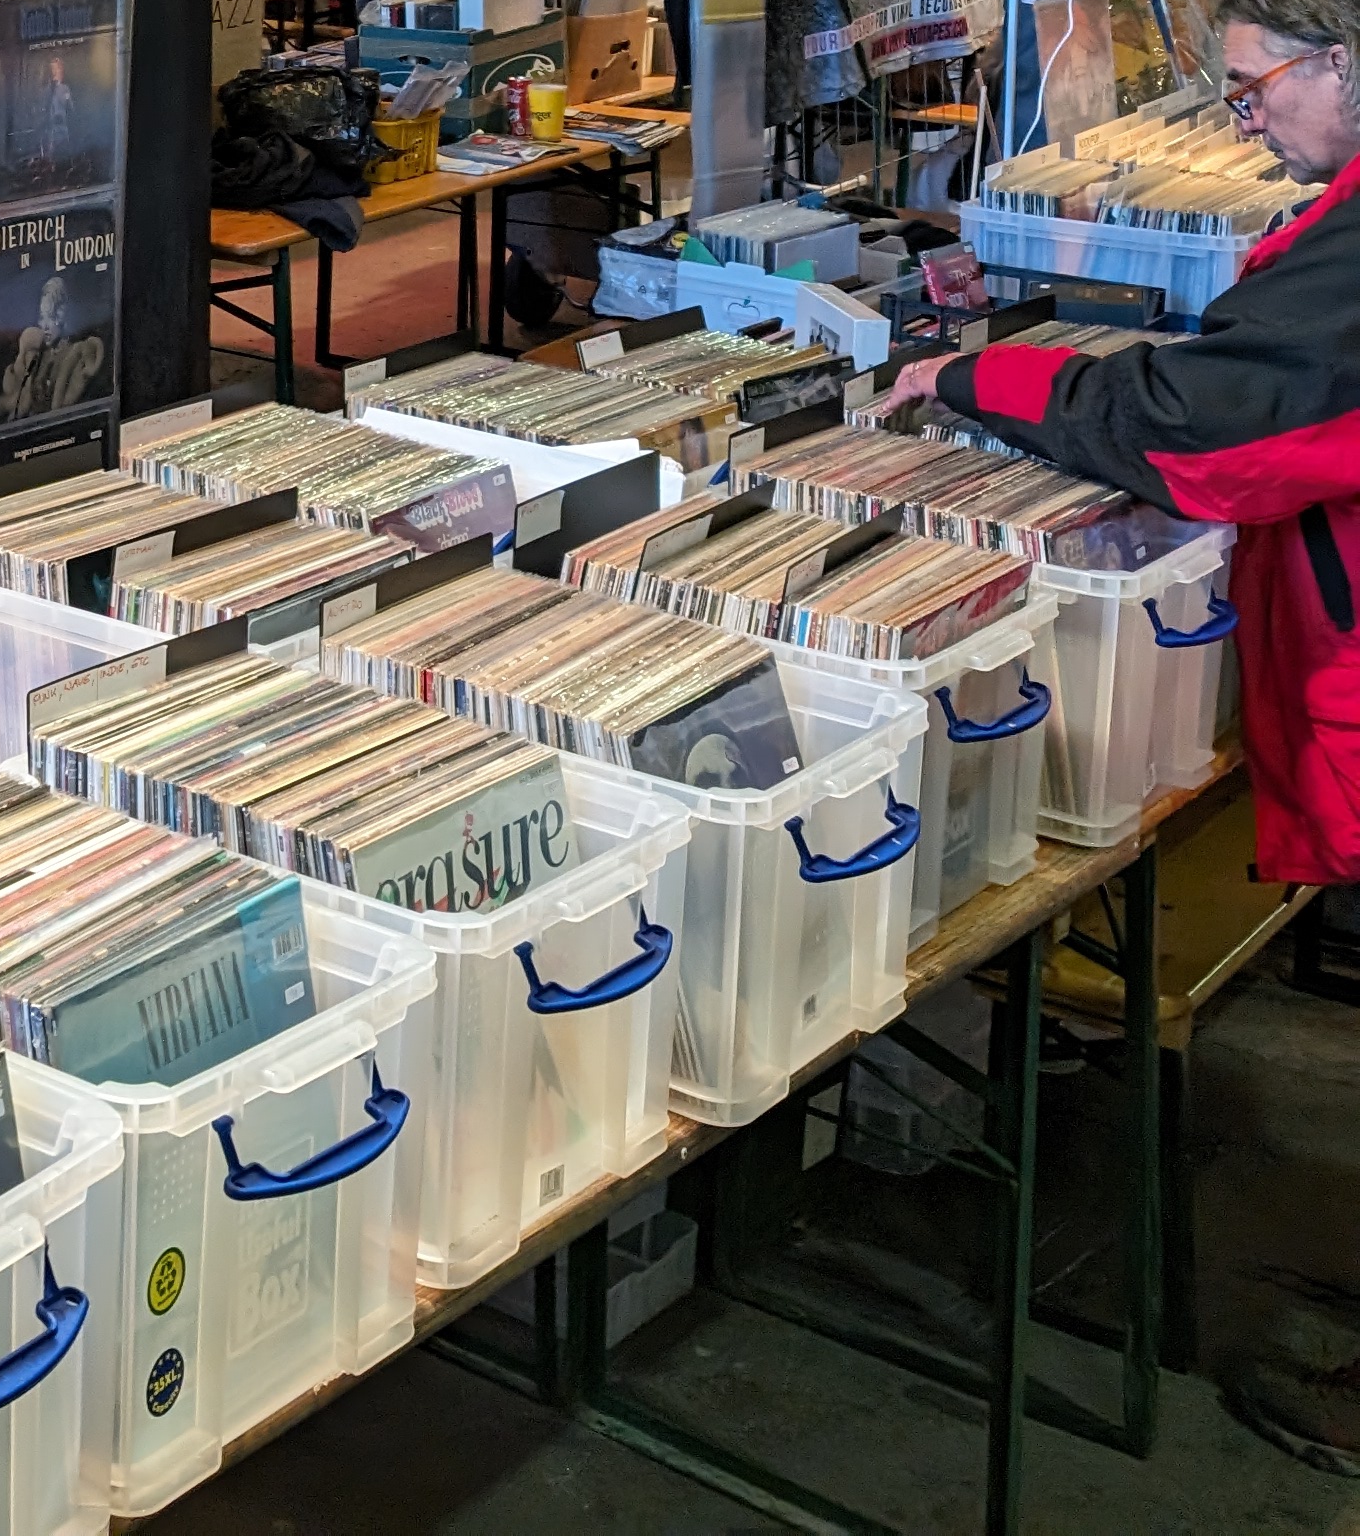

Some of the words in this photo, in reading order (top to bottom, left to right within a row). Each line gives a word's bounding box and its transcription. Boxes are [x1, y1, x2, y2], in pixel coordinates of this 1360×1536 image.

[20, 252, 30, 270] IN
[55, 233, 115, 271] LONDON
[410, 500, 452, 530] Black
[373, 800, 570, 915] erasure
[137, 951, 252, 1073] NIRVANA
